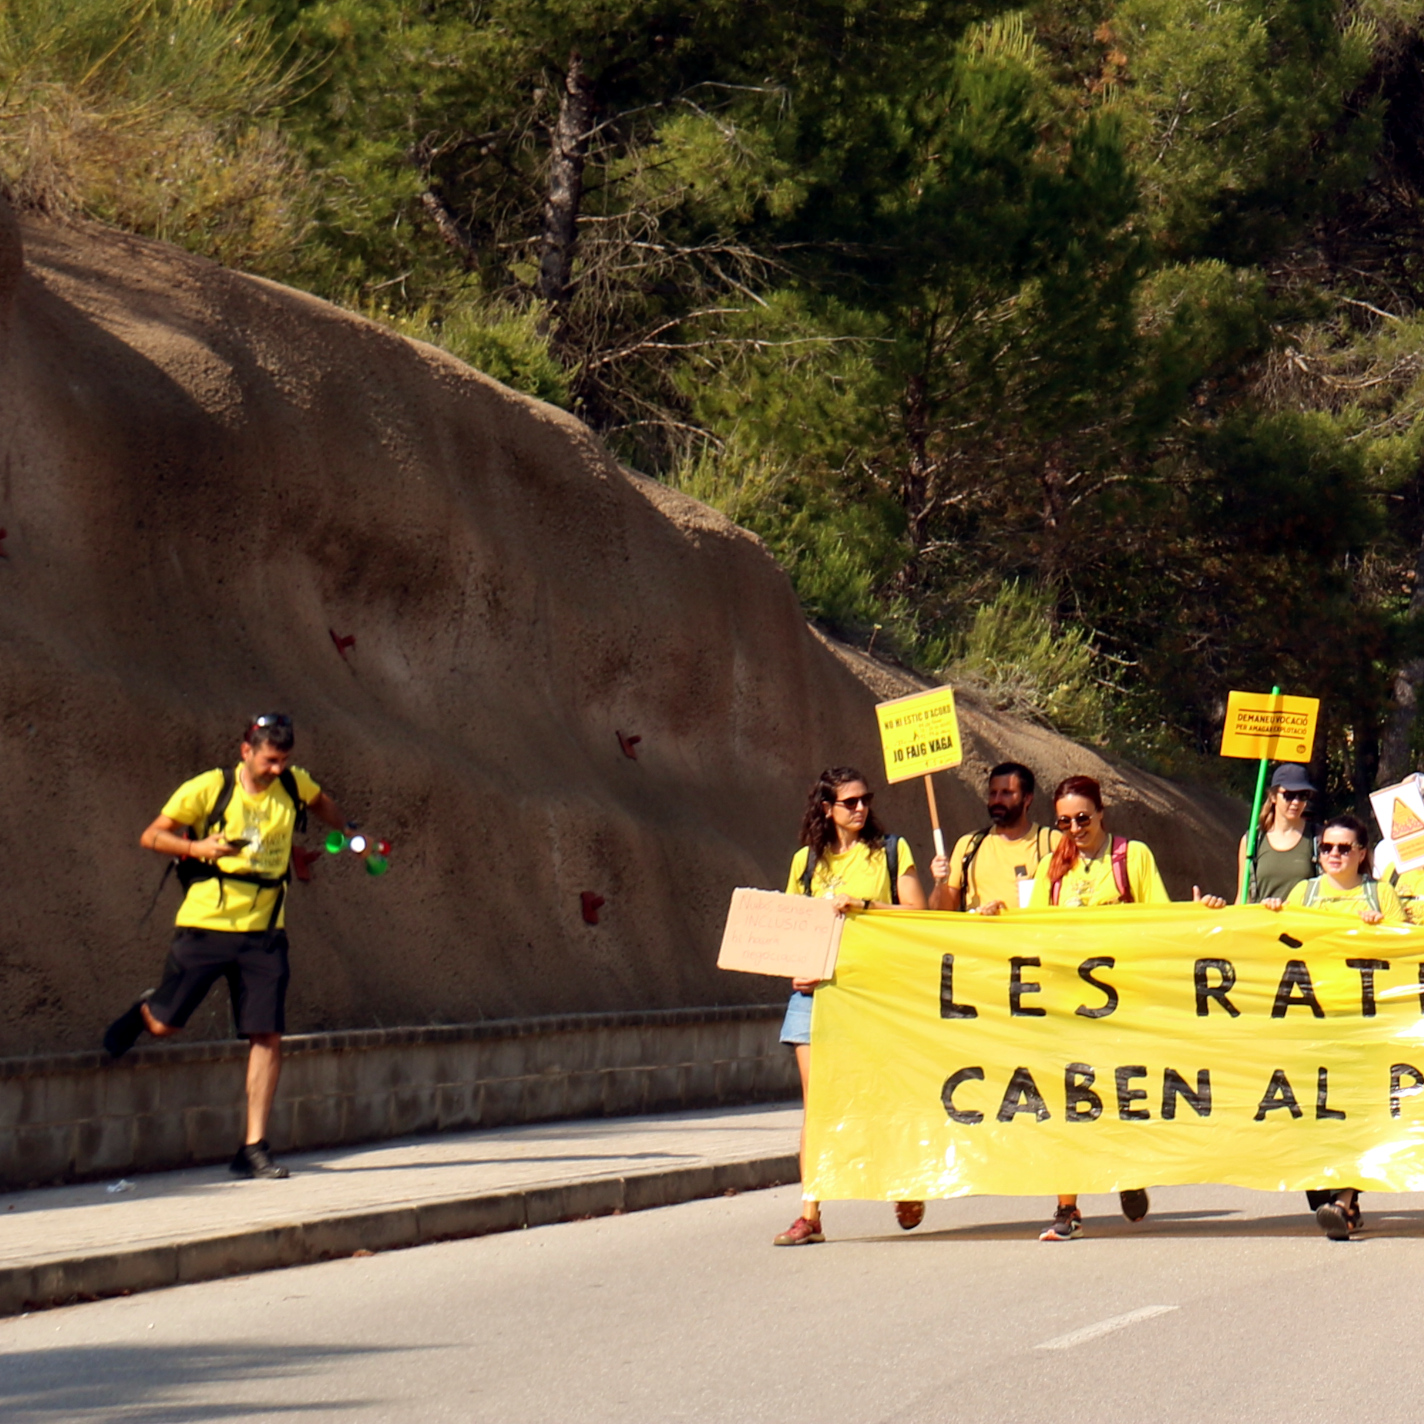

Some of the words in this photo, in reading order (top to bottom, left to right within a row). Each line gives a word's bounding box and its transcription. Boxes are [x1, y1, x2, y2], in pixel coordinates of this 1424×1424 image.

[884, 720, 893, 730] NO
[903, 712, 923, 726] ESTIC
[1238, 714, 1274, 724] DEMANEU
[1275, 715, 1308, 726] VOCACIÓ
[893, 748, 904, 763] JO
[905, 742, 927, 759] FAIG
[928, 736, 953, 753] VAGA
[939, 952, 1119, 1020] LES
[940, 1061, 1212, 1125] CABEN
[1252, 1066, 1347, 1122] AL
